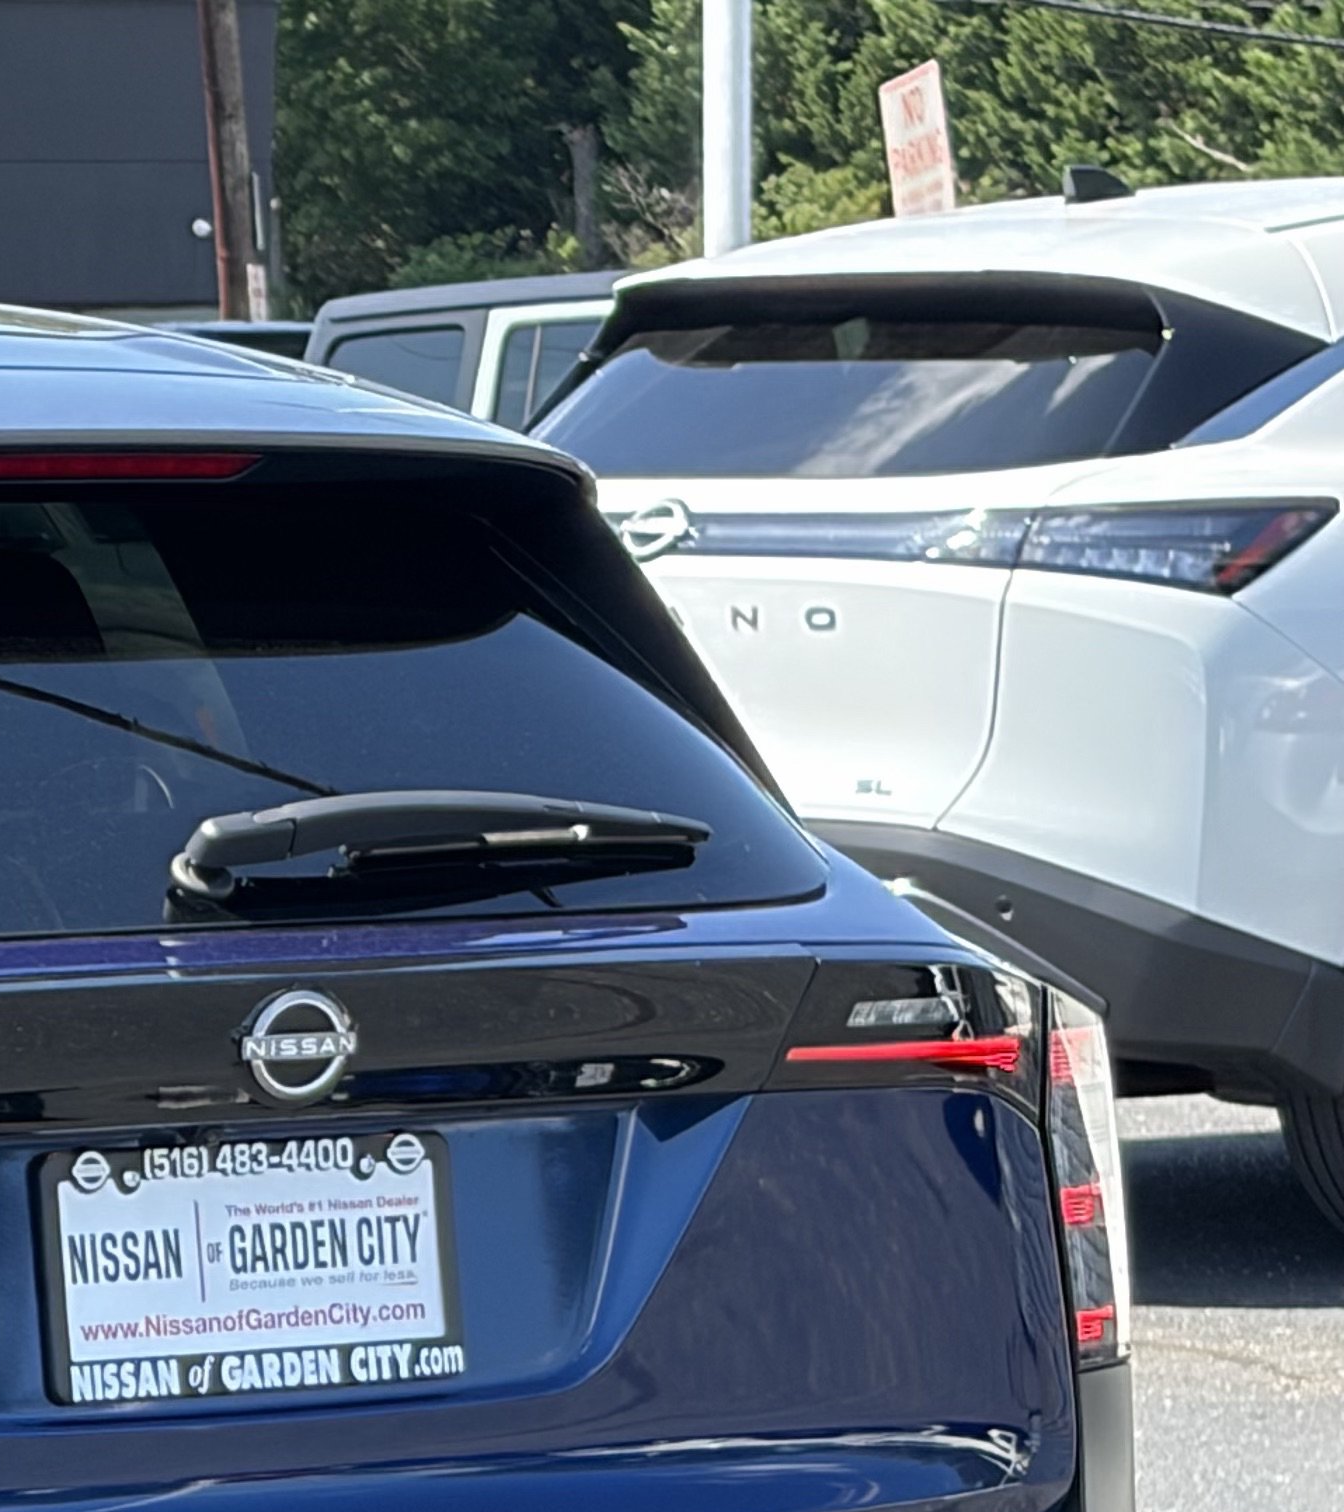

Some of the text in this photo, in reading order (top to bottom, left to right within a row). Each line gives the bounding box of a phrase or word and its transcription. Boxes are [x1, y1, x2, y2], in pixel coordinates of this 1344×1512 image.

[246, 1036, 355, 1057] NISSAN
[143, 1137, 354, 1179] (516) 483-4400
[224, 1203, 251, 1218] The
[376, 1194, 420, 1208] Dealer
[67, 1213, 421, 1285] NISSAN OF GARDEN CITY
[229, 1275, 296, 1292] Because
[300, 1274, 324, 1286] we
[328, 1270, 355, 1285] sell
[359, 1269, 379, 1283] for
[80, 1302, 425, 1341] www.NissanofGardenCity.com
[70, 1358, 181, 1403] NISSAN
[188, 1355, 215, 1394] of
[221, 1348, 341, 1391] GARDEN
